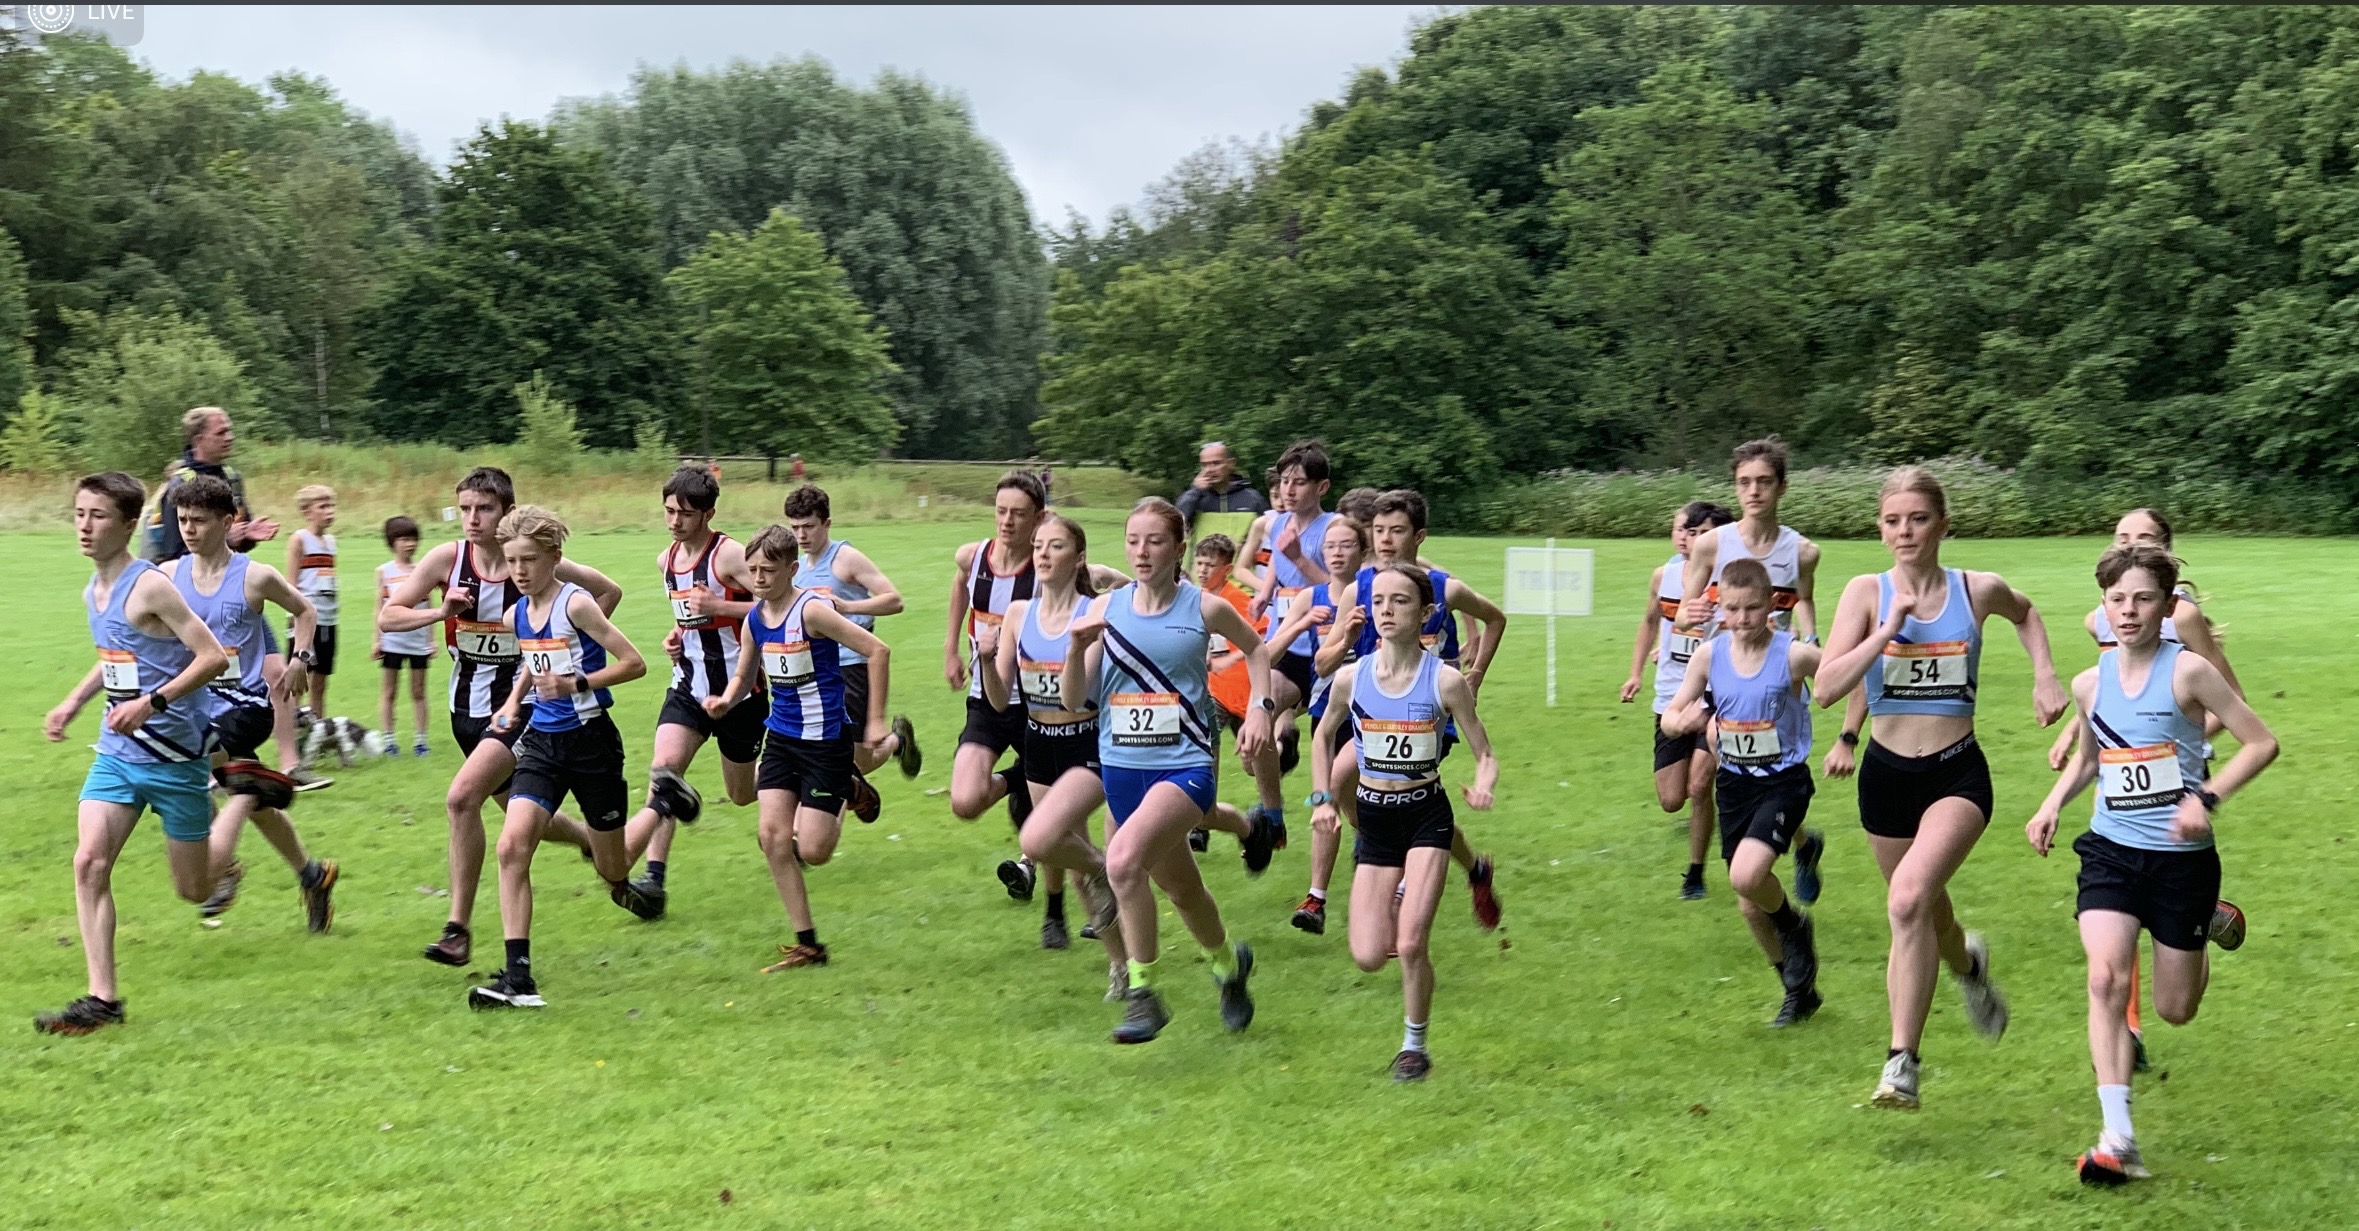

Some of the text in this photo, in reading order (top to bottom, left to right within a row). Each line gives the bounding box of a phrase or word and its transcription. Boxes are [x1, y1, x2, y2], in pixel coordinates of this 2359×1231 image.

[475, 634, 500, 654] 76
[532, 652, 552, 674] 80
[779, 655, 789, 675] 8
[1909, 658, 1940, 684] 54
[1038, 674, 1060, 694] 55
[1040, 723, 1077, 737] NIKE
[1129, 708, 1155, 732] 32
[1118, 736, 1174, 744] SPORTSSHOES.COM
[1385, 734, 1413, 759] 26
[1735, 734, 1757, 755] 12
[1940, 742, 1964, 762] NIKE
[1371, 762, 1431, 770] SPORTSSHOES.COM
[2121, 764, 2151, 793] 30
[1383, 788, 1428, 805] PRO
[2111, 794, 2178, 807] SPORTSSHOES.COM
